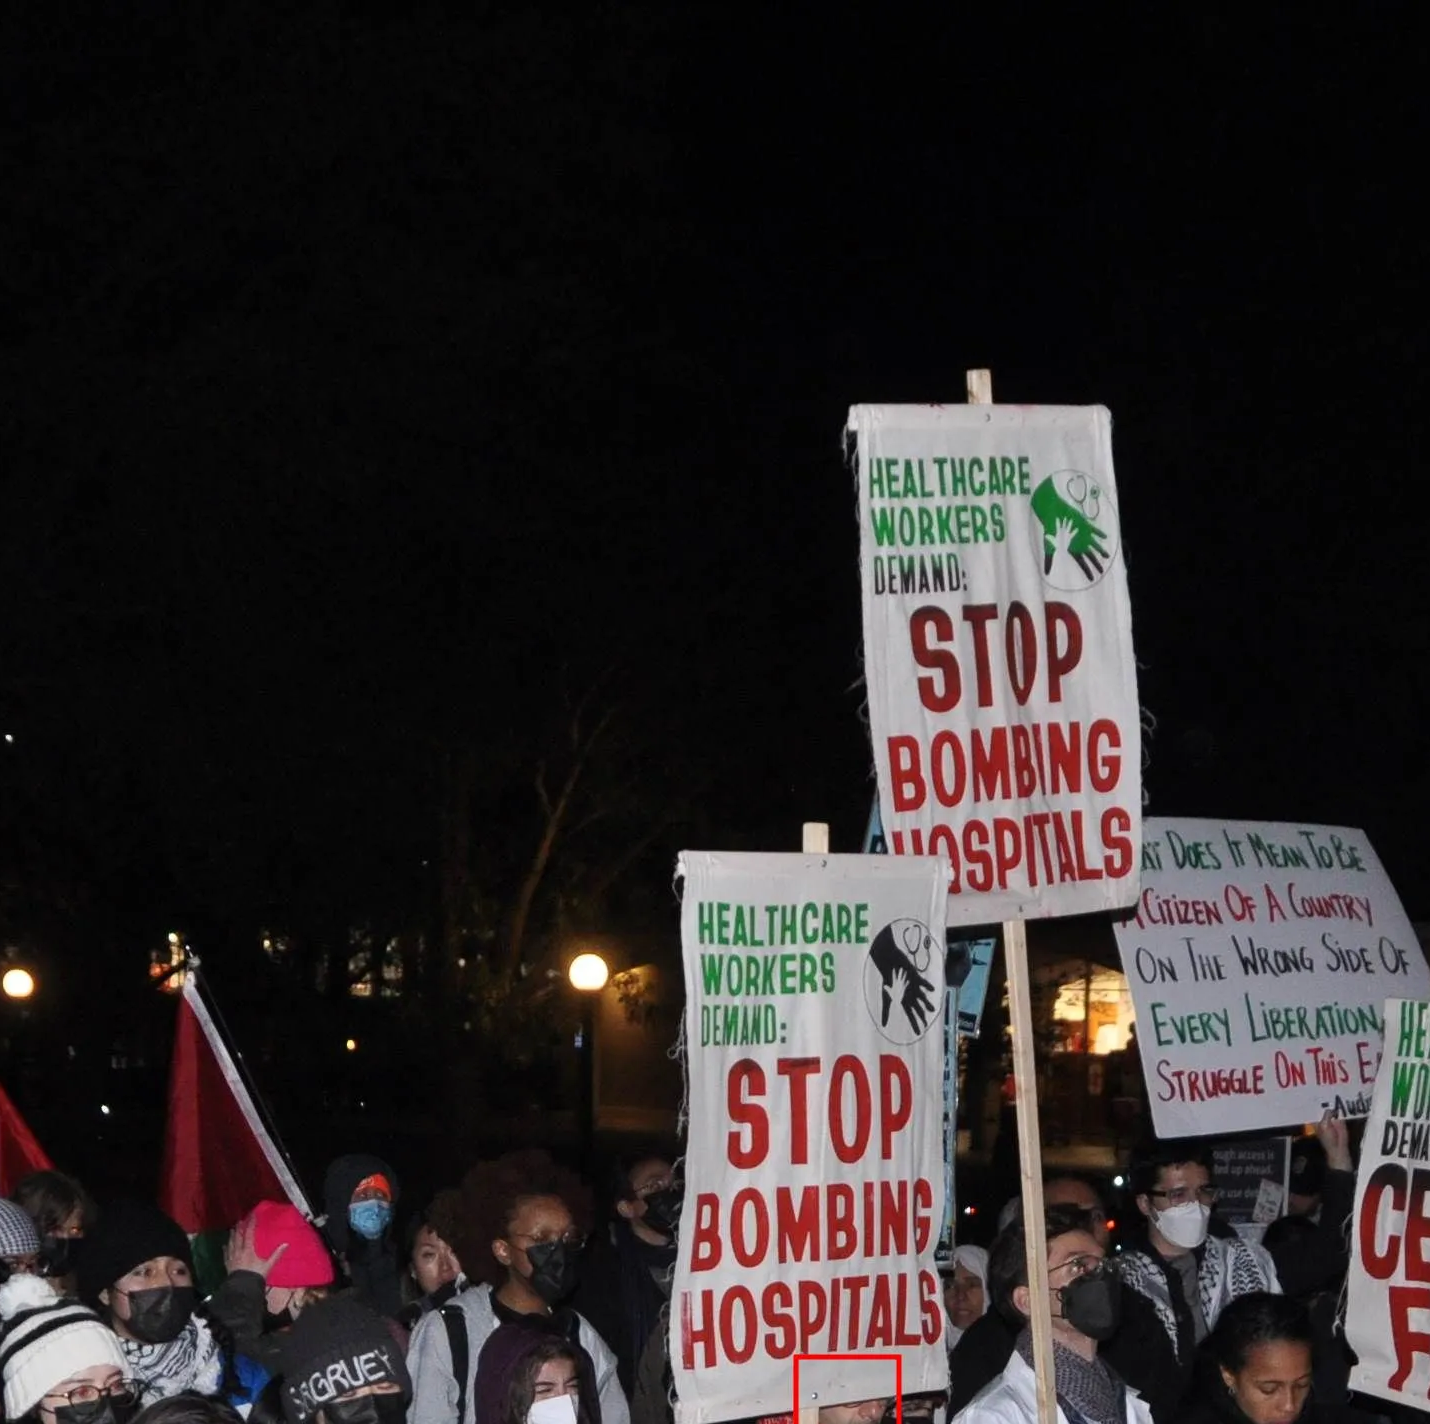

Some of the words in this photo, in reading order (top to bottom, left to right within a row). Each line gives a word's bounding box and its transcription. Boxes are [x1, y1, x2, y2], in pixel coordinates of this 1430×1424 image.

[870, 456, 1031, 498] HEALTHCARE
[871, 503, 1005, 546] WORKERS
[874, 553, 968, 595] DEMAND:
[909, 600, 1083, 713] STOP
[887, 719, 1122, 813] BOMBING
[1166, 830, 1221, 870] DOES
[1223, 828, 1246, 867] IT
[1247, 832, 1311, 869] MEAN
[1299, 831, 1332, 869] TO
[1330, 834, 1367, 872] BE
[698, 902, 869, 946] HEALTHCARE
[1224, 884, 1257, 922] OF
[1264, 883, 1286, 922] A
[1287, 882, 1374, 927] COUNTRY
[700, 952, 835, 996] WORKERS
[1135, 947, 1178, 984] ON
[1182, 937, 1226, 982] THE
[1231, 935, 1314, 977] WRONG
[1378, 936, 1411, 976] OF
[701, 1004, 787, 1047] DEMAND:
[1151, 1003, 1233, 1047] EVERY
[1157, 1059, 1265, 1102] STRUGGLE
[1274, 1051, 1305, 1088] ON
[727, 1054, 912, 1170] STOP
[690, 1177, 933, 1272] BOMBING
[681, 1269, 942, 1370] HOSPITALS
